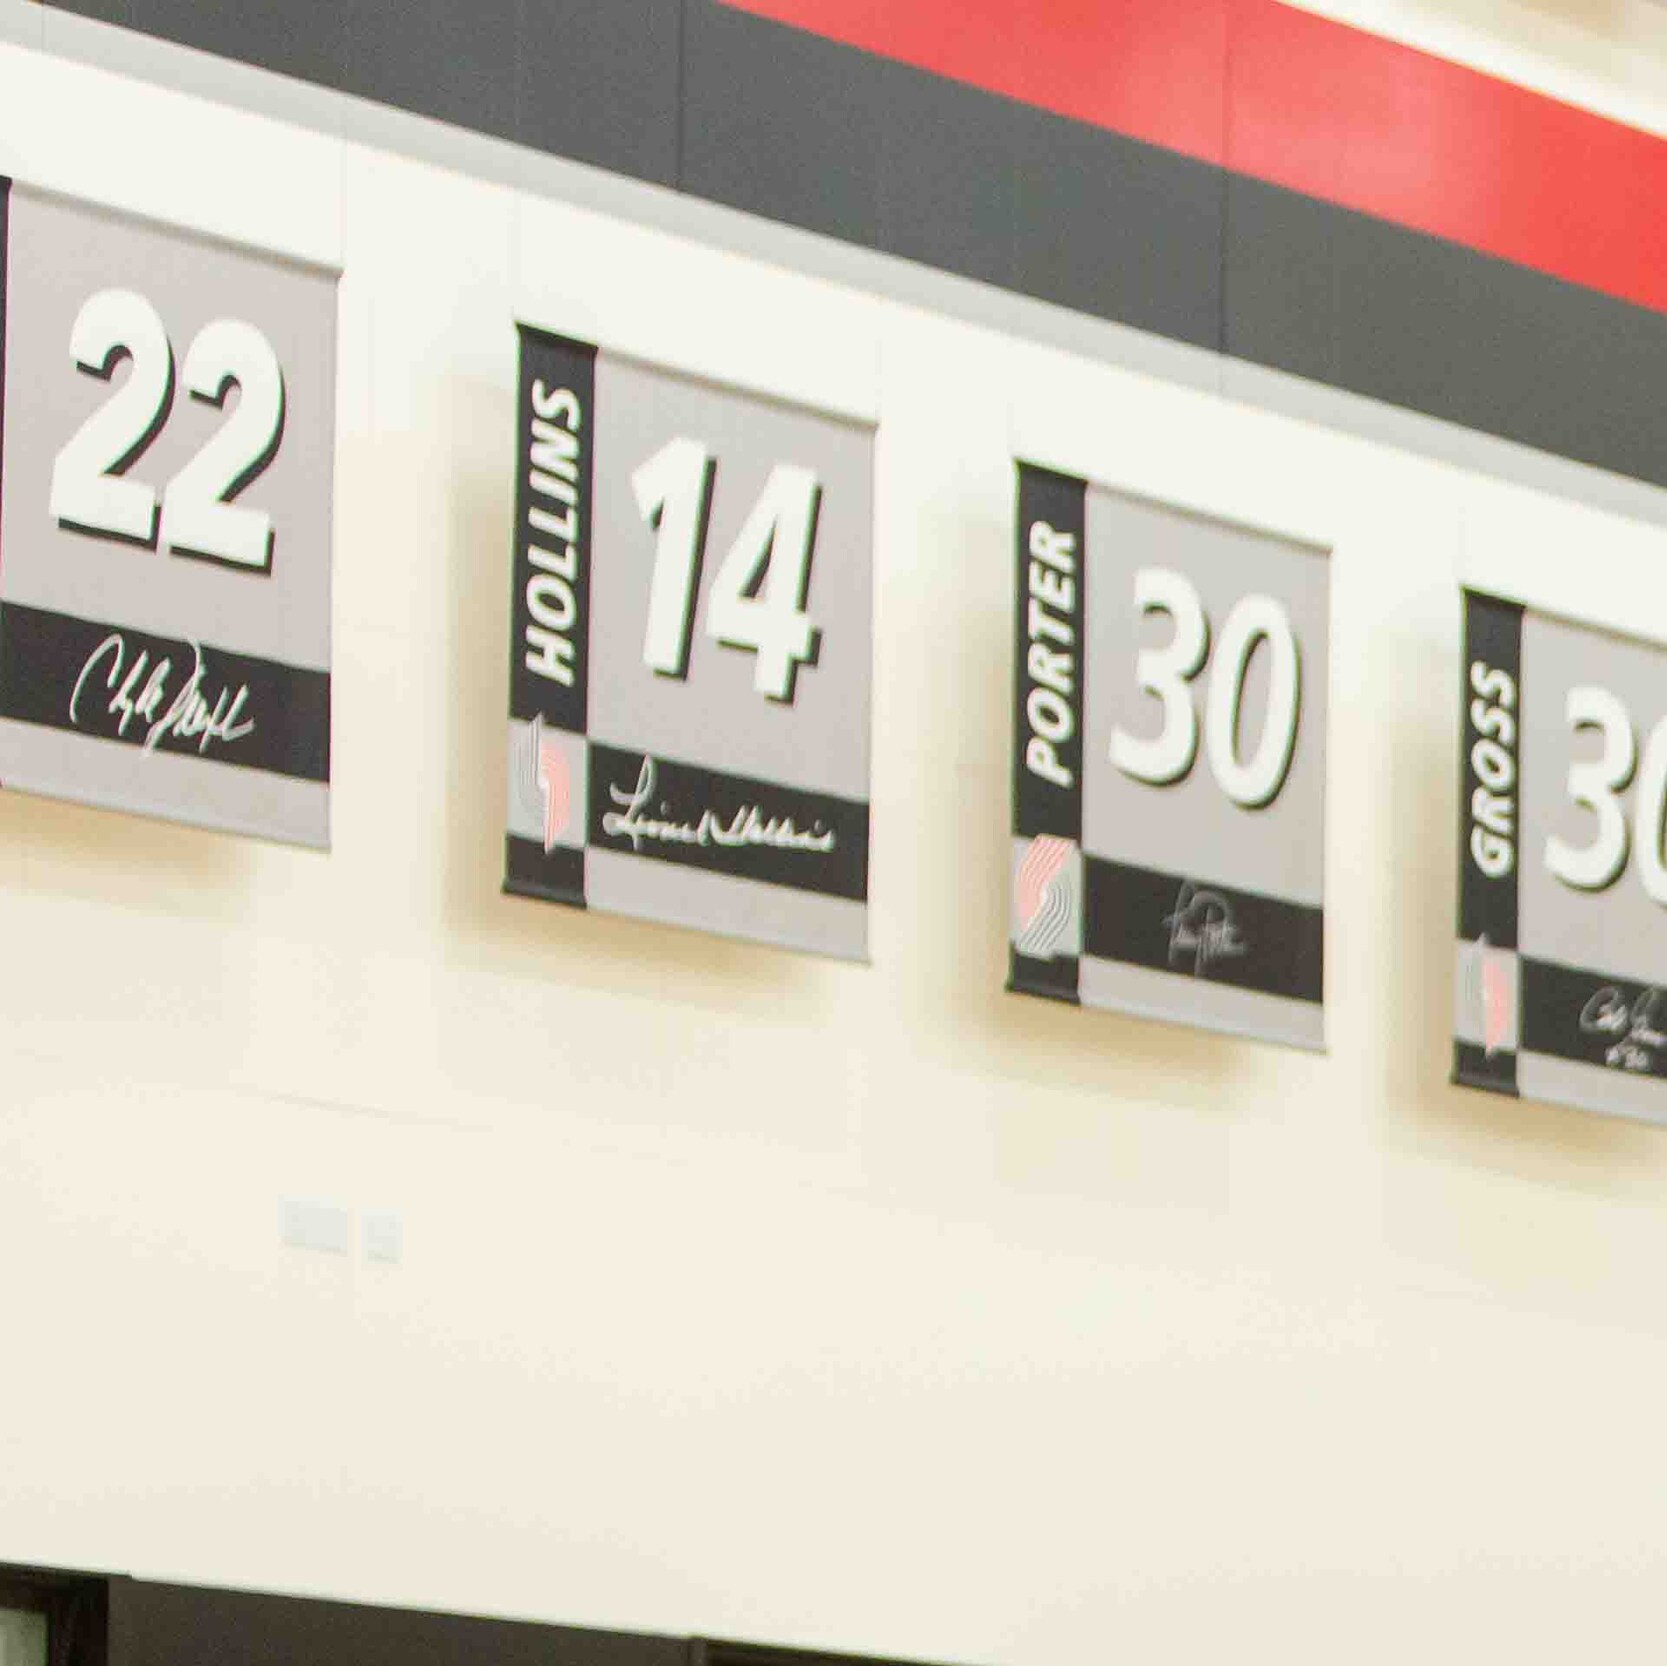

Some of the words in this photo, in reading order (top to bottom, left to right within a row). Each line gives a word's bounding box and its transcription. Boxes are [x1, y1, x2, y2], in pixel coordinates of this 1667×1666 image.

[49, 288, 286, 575] 22
[526, 377, 582, 687] HOLLINS
[631, 435, 821, 707] 14
[1026, 520, 1077, 788] PORTER
[1108, 568, 1301, 810] 30
[1470, 661, 1517, 879] GROSS
